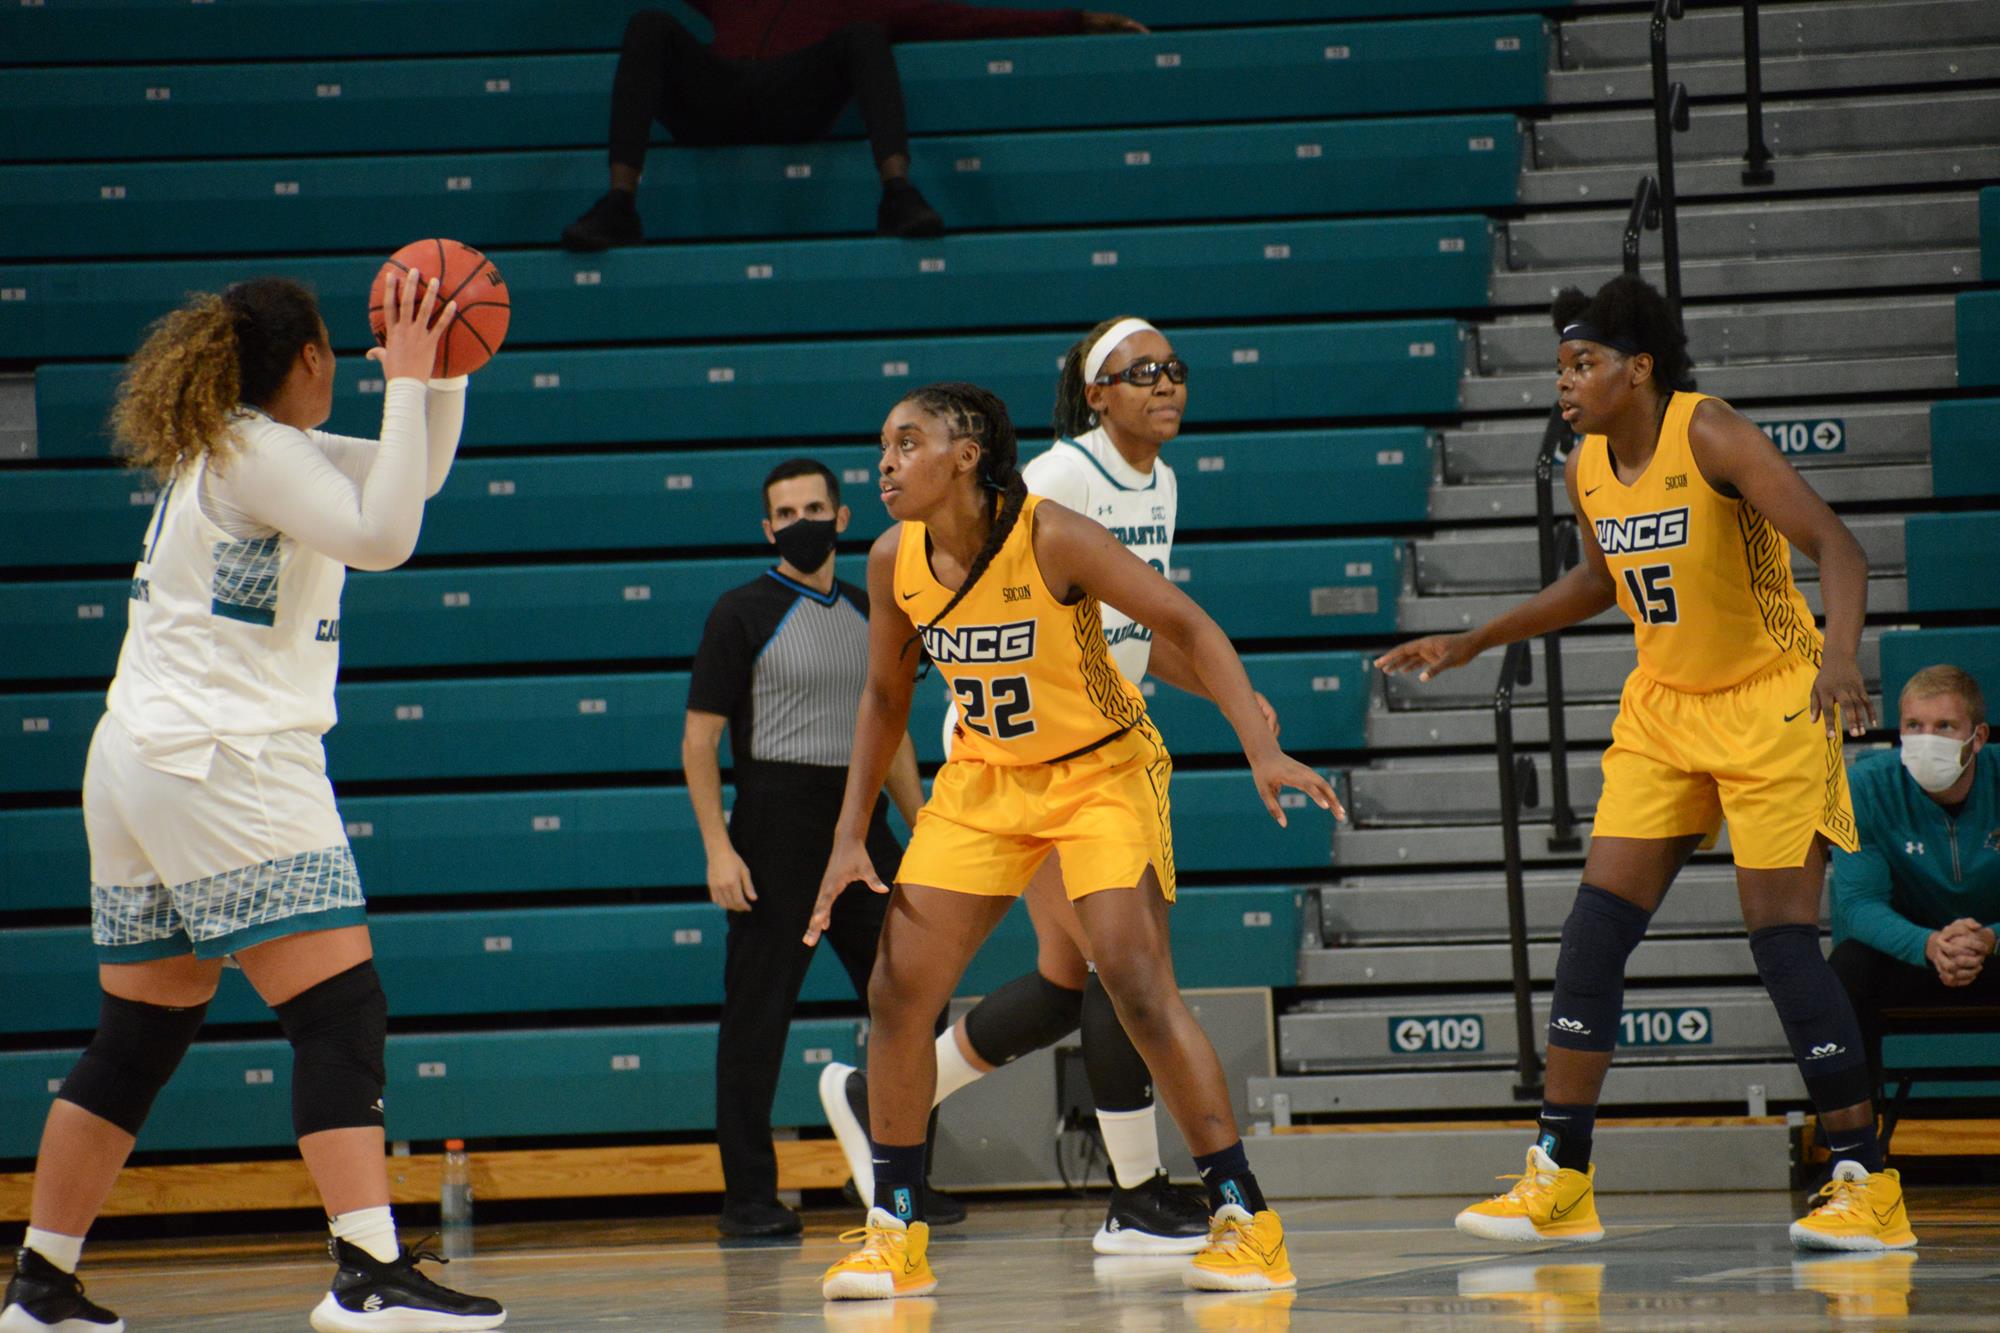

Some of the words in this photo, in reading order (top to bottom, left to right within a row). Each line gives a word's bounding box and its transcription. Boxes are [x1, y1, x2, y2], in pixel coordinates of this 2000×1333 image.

[1596, 506, 1690, 556] UNCG
[1002, 585, 1031, 603] SOCON
[1624, 564, 1678, 625] 15
[917, 618, 1037, 664] UNCG
[952, 675, 1036, 738] 22
[1426, 1018, 1480, 1050] 109
[1620, 1011, 1673, 1043] 110
